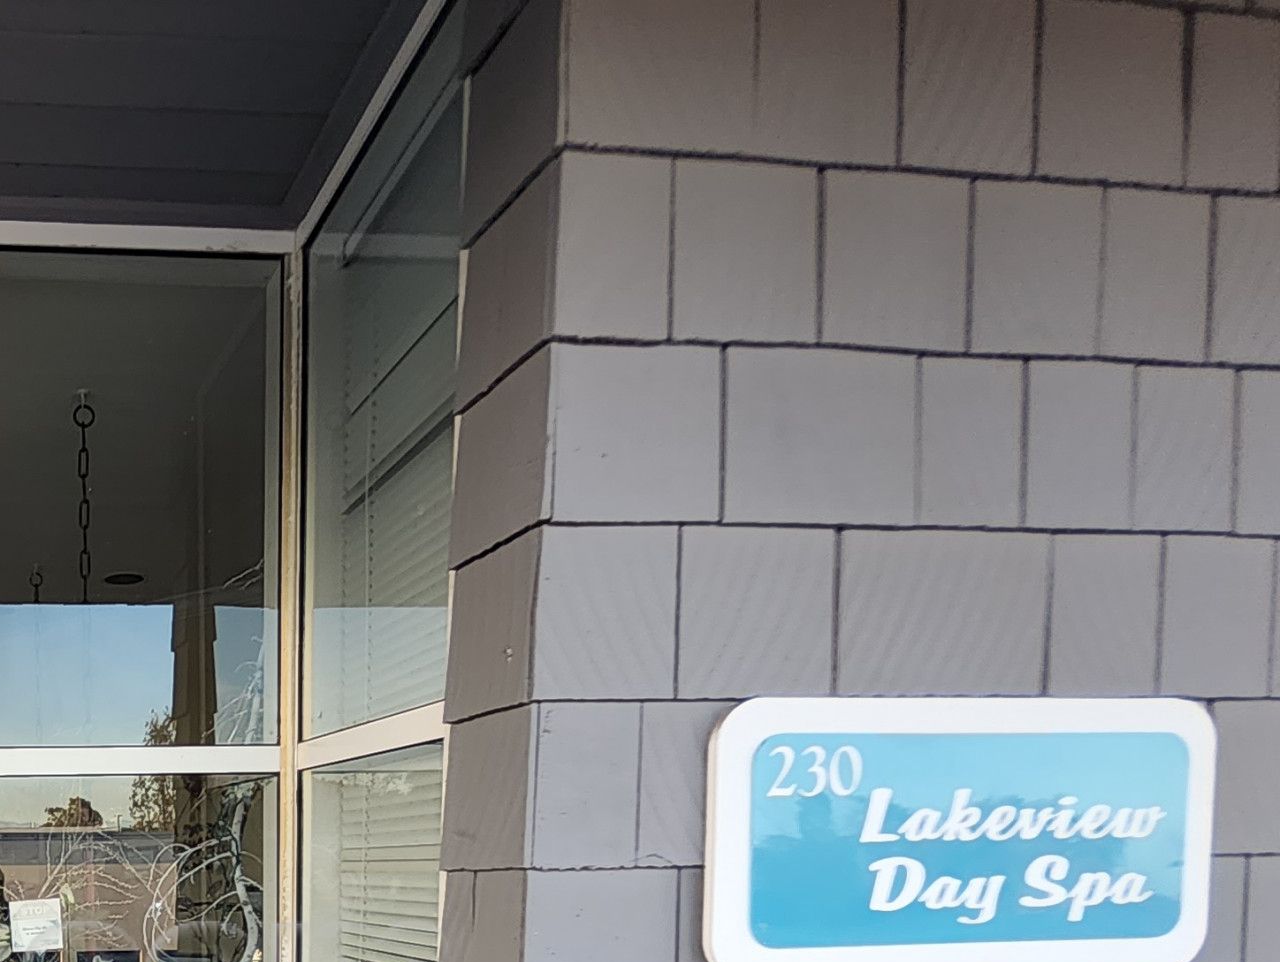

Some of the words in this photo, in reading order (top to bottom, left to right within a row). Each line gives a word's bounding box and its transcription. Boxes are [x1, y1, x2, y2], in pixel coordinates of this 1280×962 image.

[766, 744, 863, 798] 230
[859, 787, 1167, 843] Lakeview
[869, 856, 1007, 924] Day
[1019, 854, 1156, 922] Spa
